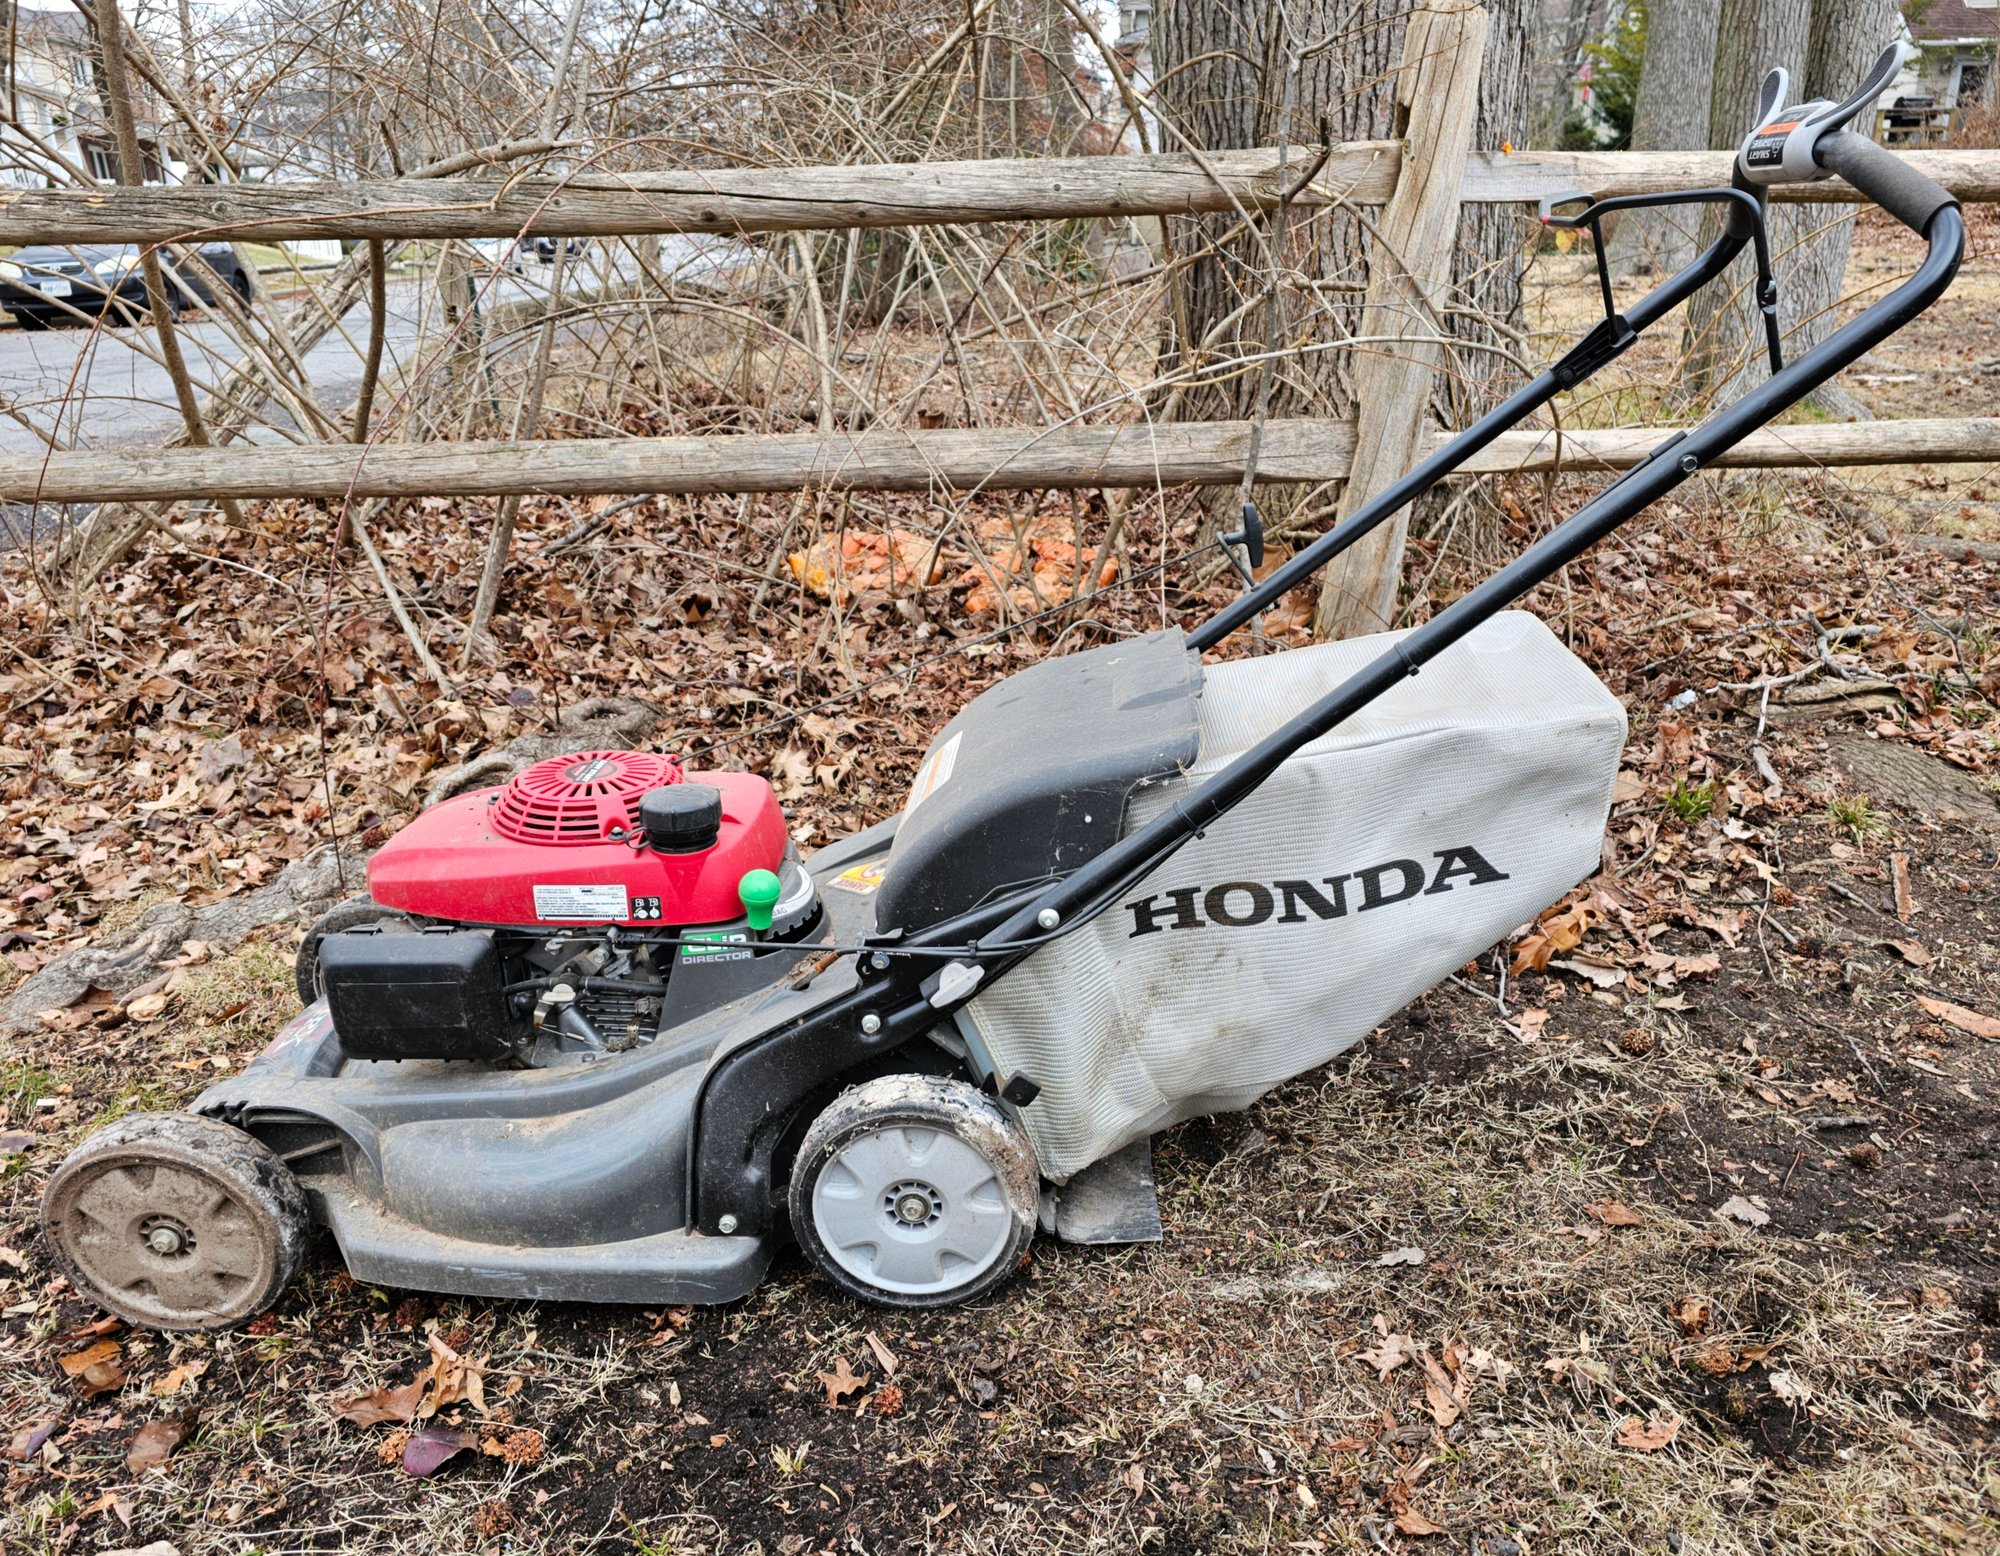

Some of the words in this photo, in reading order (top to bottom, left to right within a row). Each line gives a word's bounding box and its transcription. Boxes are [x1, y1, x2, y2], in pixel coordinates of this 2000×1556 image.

[1748, 150, 1771, 160] SMART
[1125, 845, 1510, 939] HONDA
[682, 950, 752, 965] DIRECTOR
